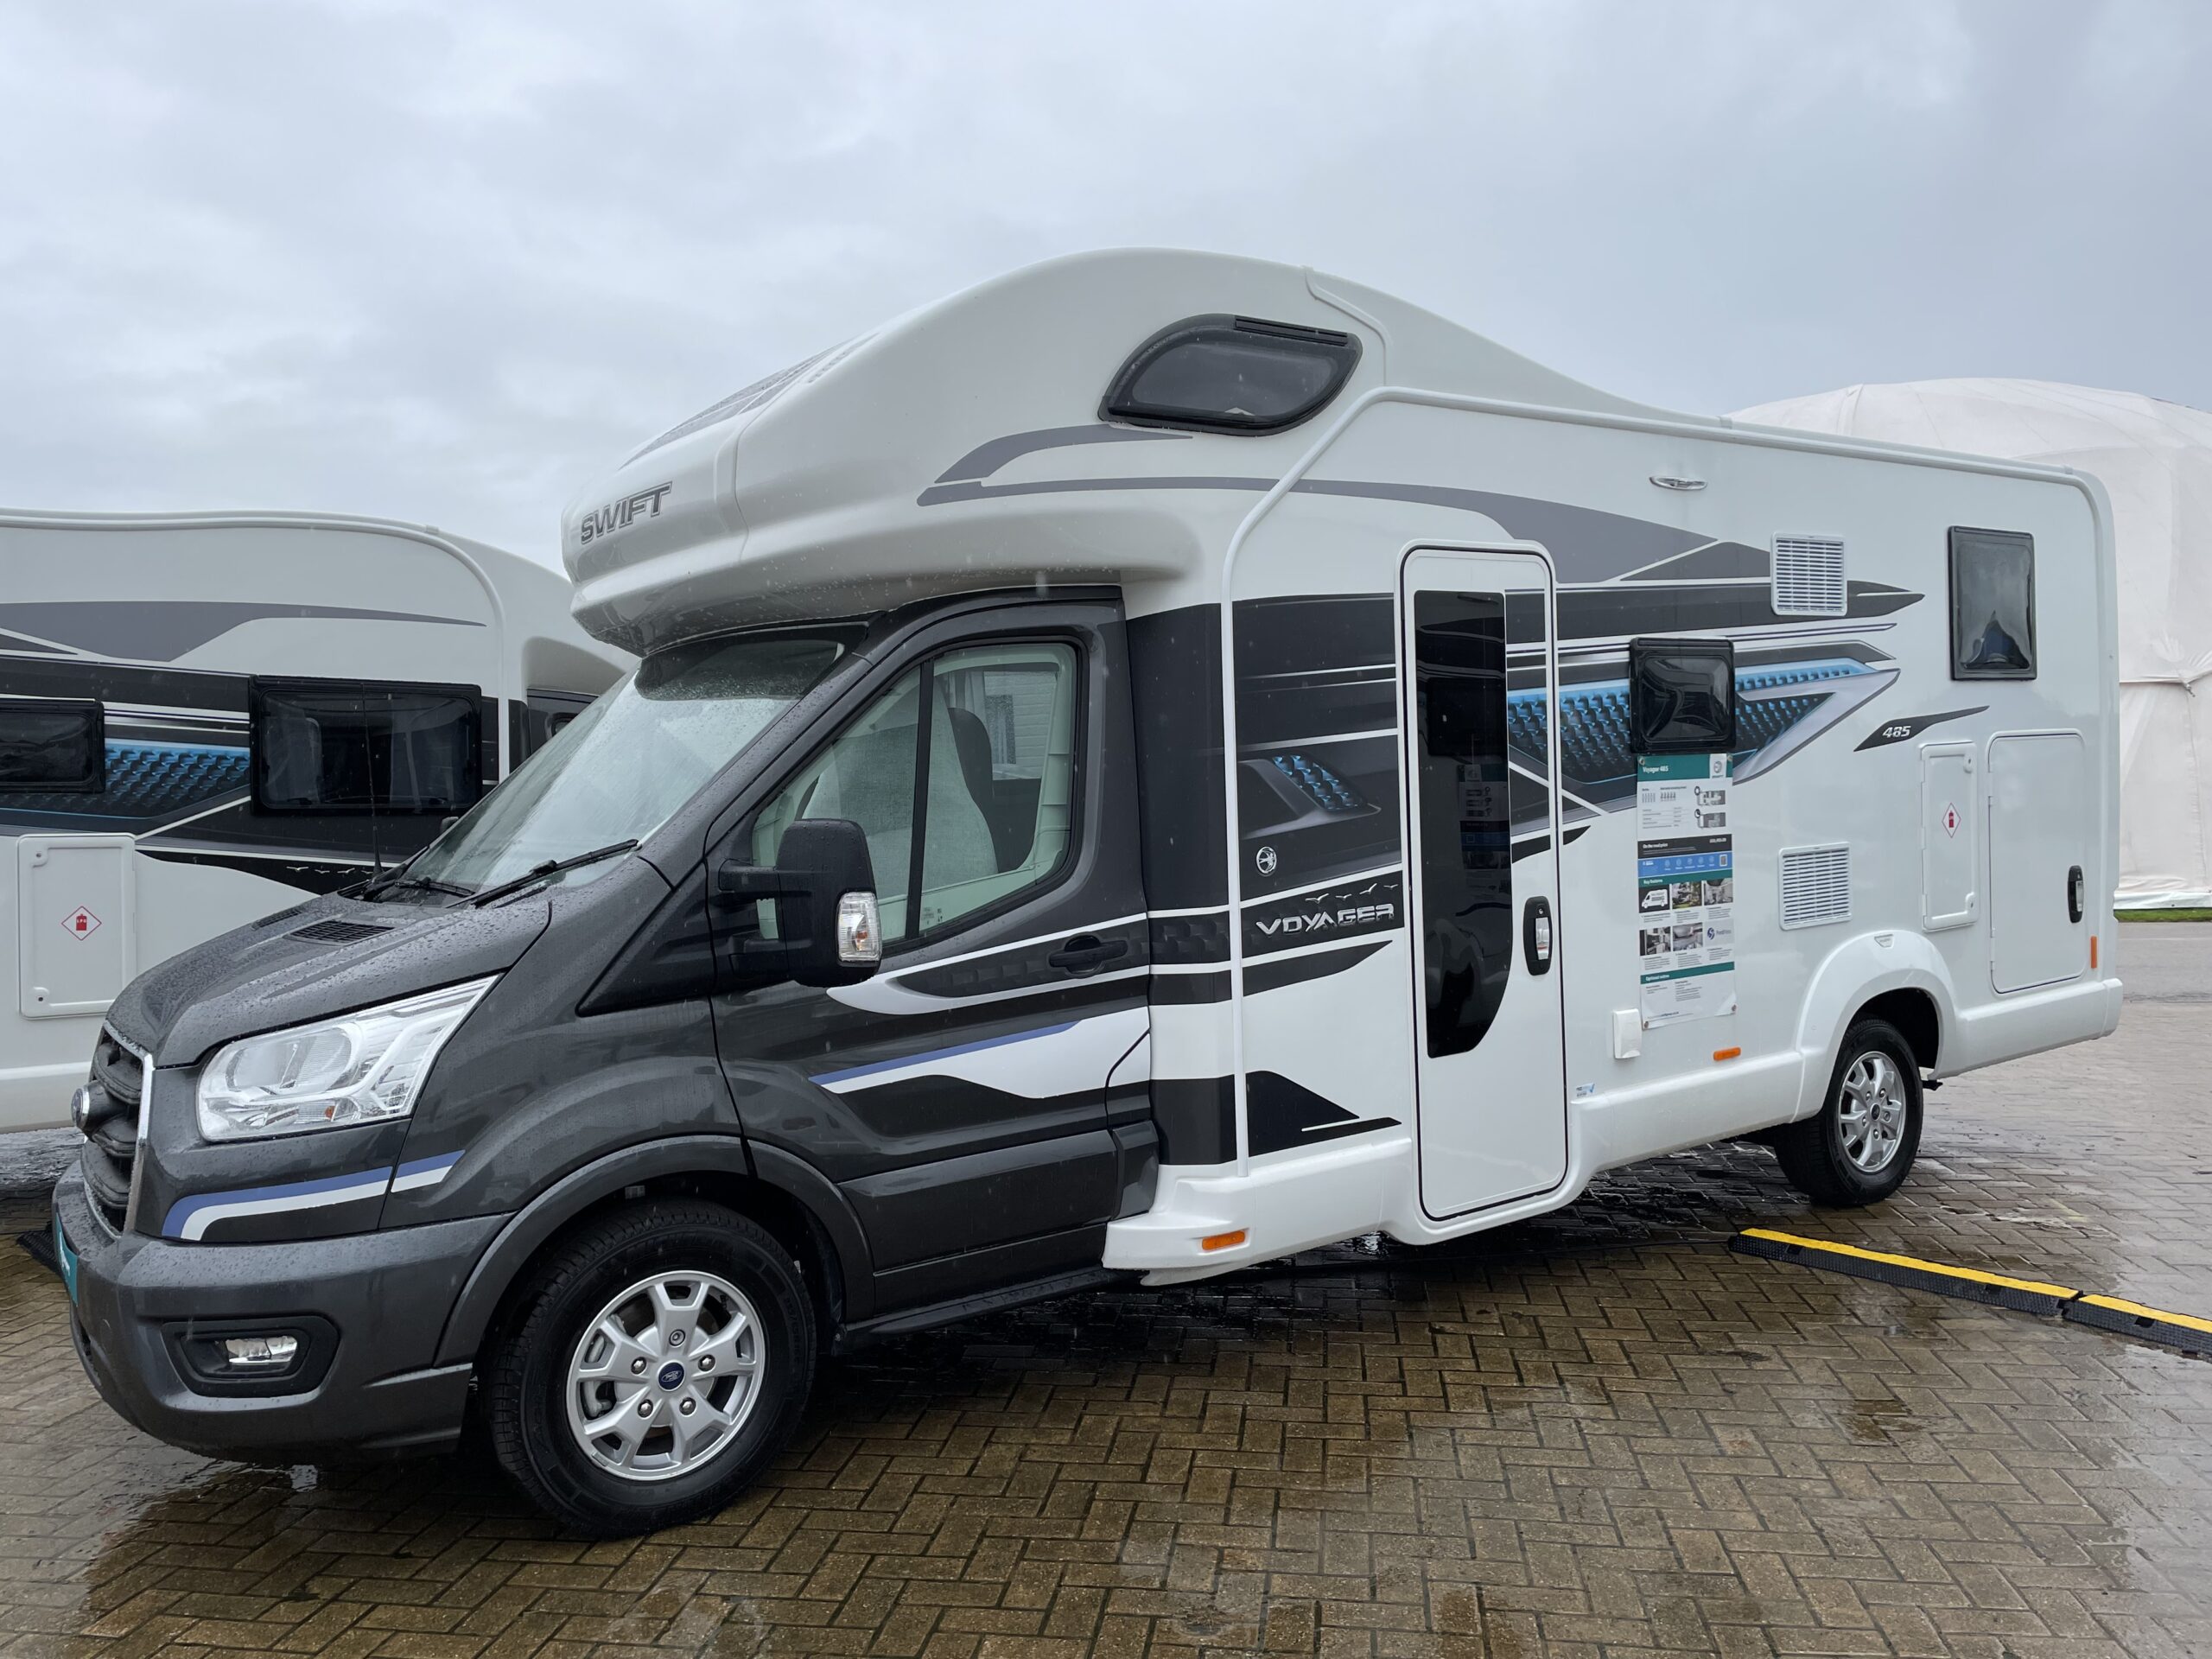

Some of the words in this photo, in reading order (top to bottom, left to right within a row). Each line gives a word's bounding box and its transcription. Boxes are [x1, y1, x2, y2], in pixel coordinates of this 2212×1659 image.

[581, 481, 673, 544] SWIFT
[1882, 725, 1911, 738] 485
[1255, 903, 1395, 936] VOYAGER
